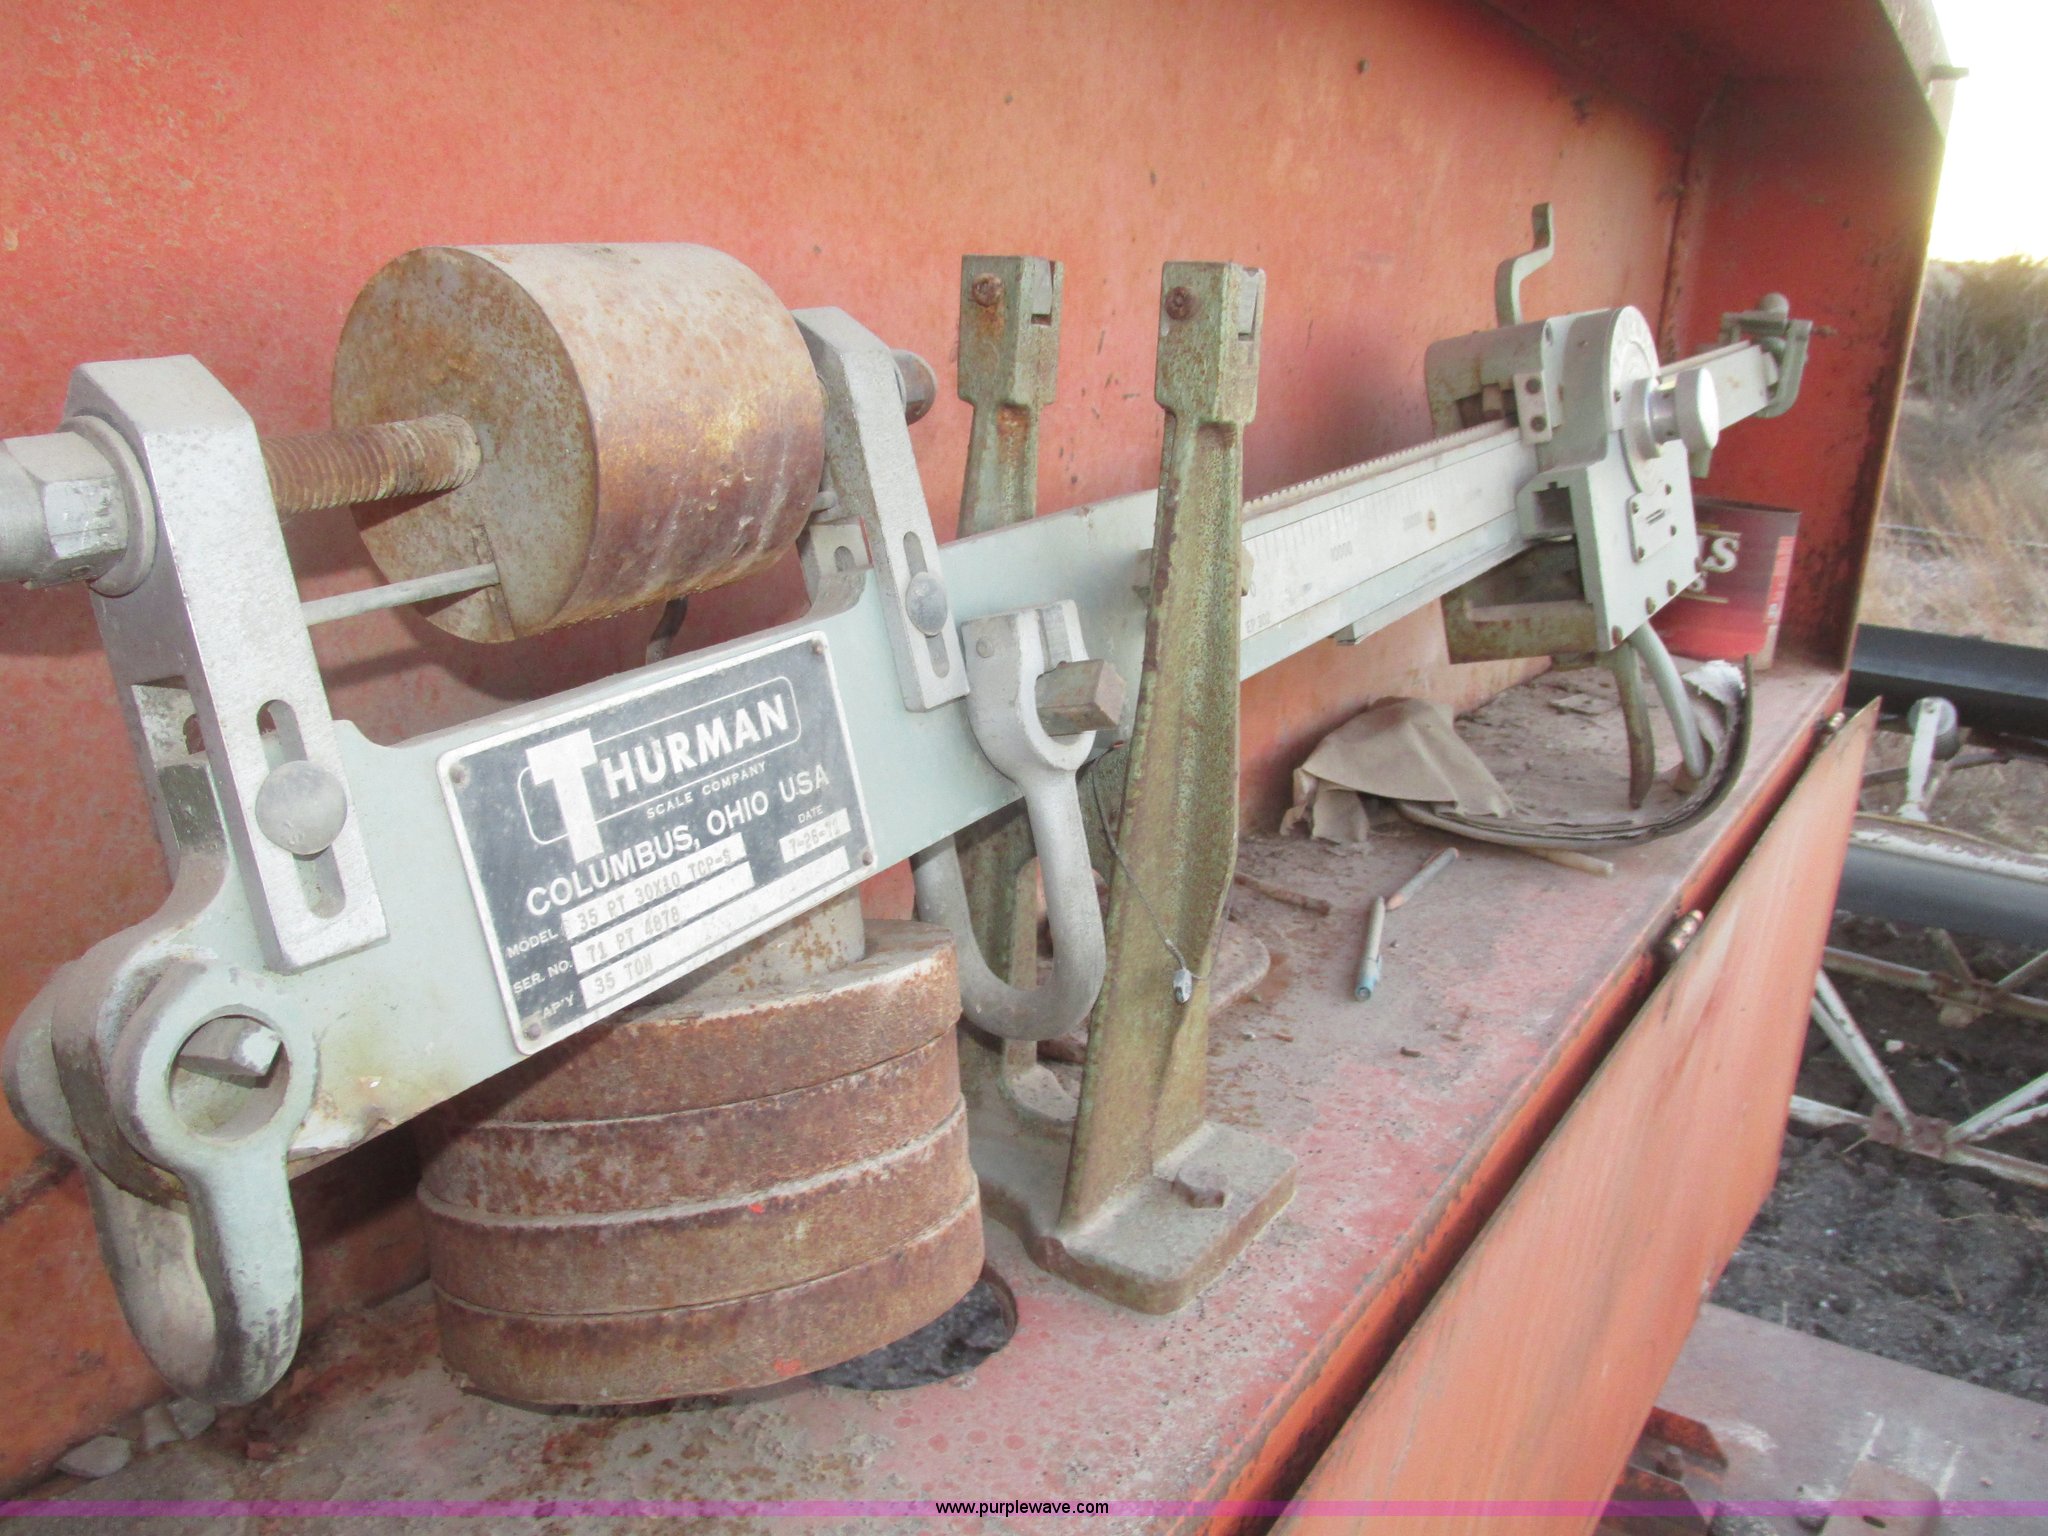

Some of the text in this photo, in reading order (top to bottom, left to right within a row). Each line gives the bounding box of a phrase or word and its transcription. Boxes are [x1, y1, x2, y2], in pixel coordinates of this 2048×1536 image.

[525, 694, 789, 864] THURMAN
[647, 761, 766, 819] SCALE COMPANY
[797, 805, 824, 824] DATE
[526, 824, 701, 916] COLUMBUS,
[706, 791, 769, 836] OHIO
[506, 928, 559, 958] MODEL
[577, 908, 599, 931] 35
[607, 895, 625, 918] PT
[634, 871, 681, 904] 30X10
[512, 906, 681, 994] SER. NO. 71 PT 4878
[542, 953, 654, 1019] AP'Y 35 TON
